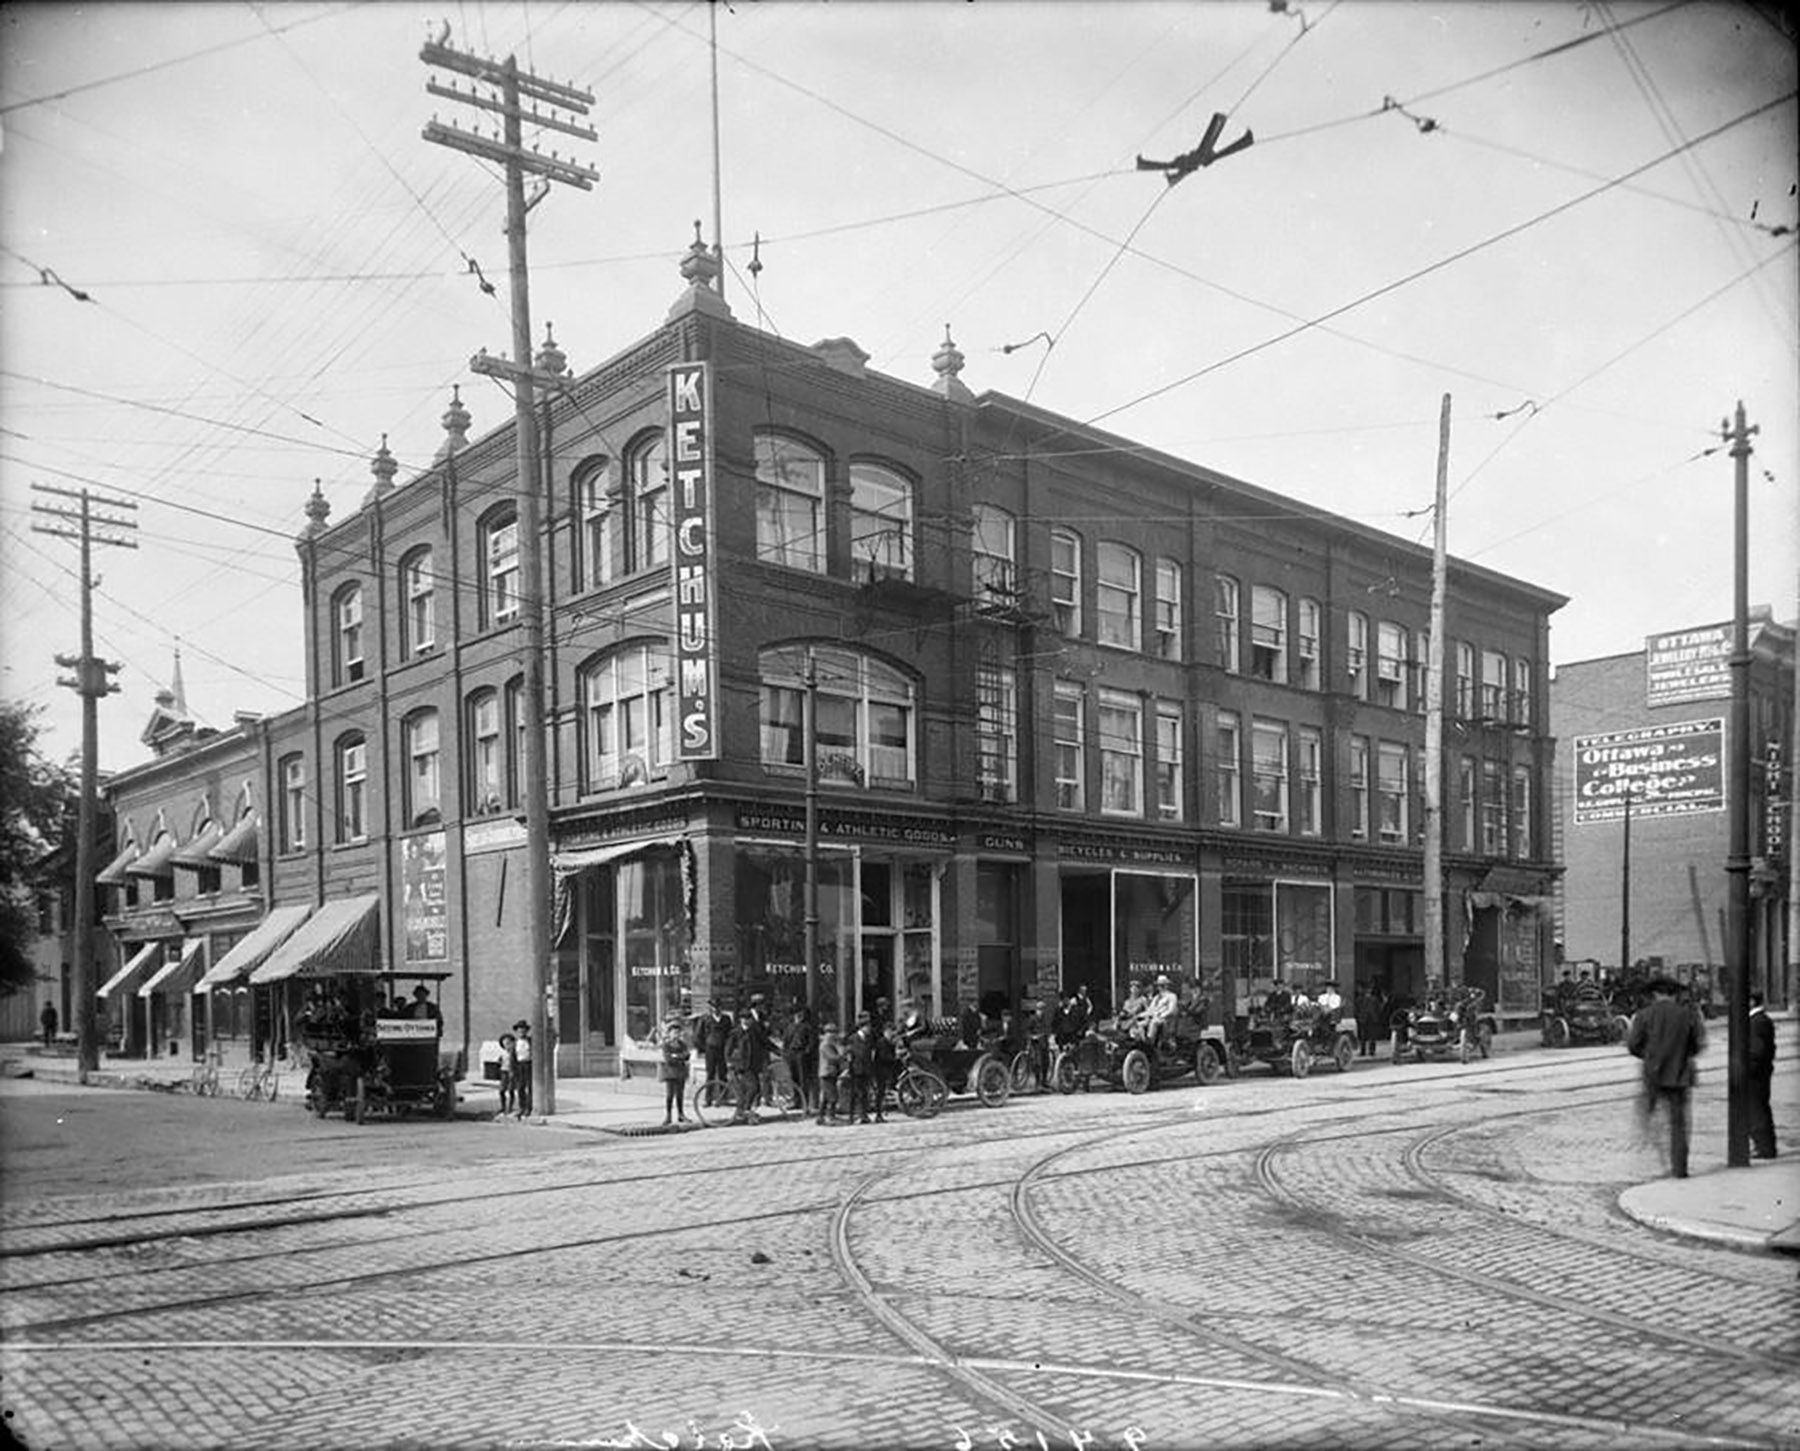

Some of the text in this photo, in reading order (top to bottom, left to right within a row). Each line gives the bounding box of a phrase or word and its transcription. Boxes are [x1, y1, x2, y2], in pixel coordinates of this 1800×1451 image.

[1582, 743, 1665, 764] Ottawa
[1608, 754, 1717, 778] Business
[741, 816, 805, 832] SPORTIN
[820, 822, 829, 833] &
[836, 823, 899, 838] ATHLETIC
